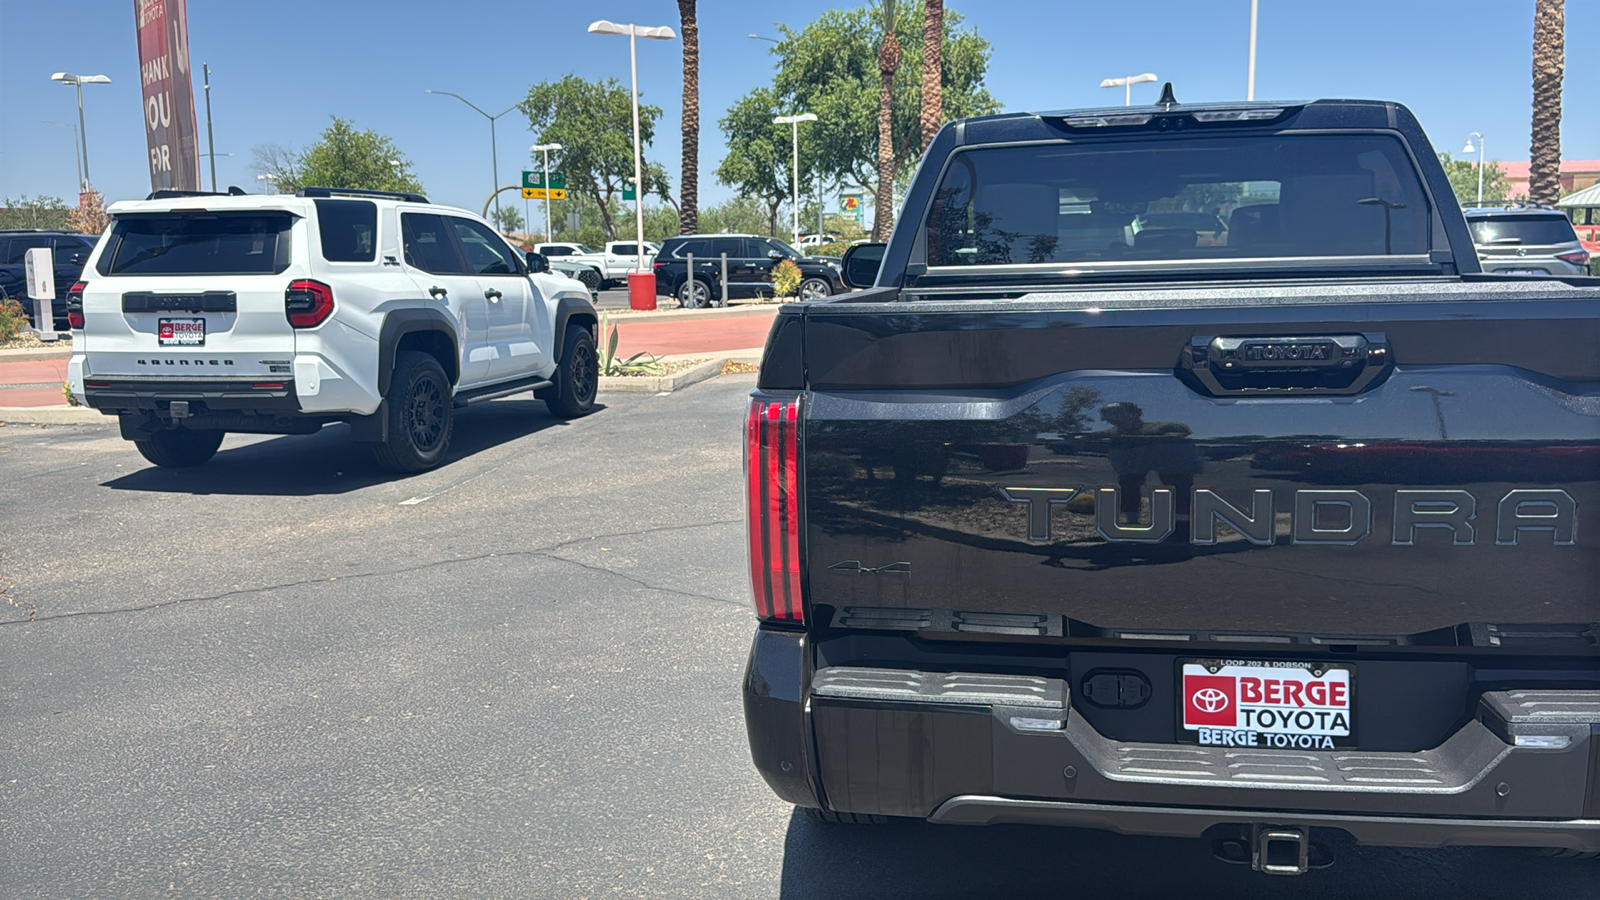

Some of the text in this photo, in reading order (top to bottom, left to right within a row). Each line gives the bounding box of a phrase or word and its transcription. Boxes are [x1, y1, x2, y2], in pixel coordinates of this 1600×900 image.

[175, 323, 203, 332] BERGE
[1253, 345, 1324, 360] TOYOTA
[1000, 487, 1577, 547] TUNDRA
[1220, 659, 1312, 669] LOOP 202 & DOBSON
[1239, 677, 1347, 708] BERGE
[1240, 709, 1349, 730] TOYOTA
[1199, 729, 1335, 749] BERGE TOYOTA
